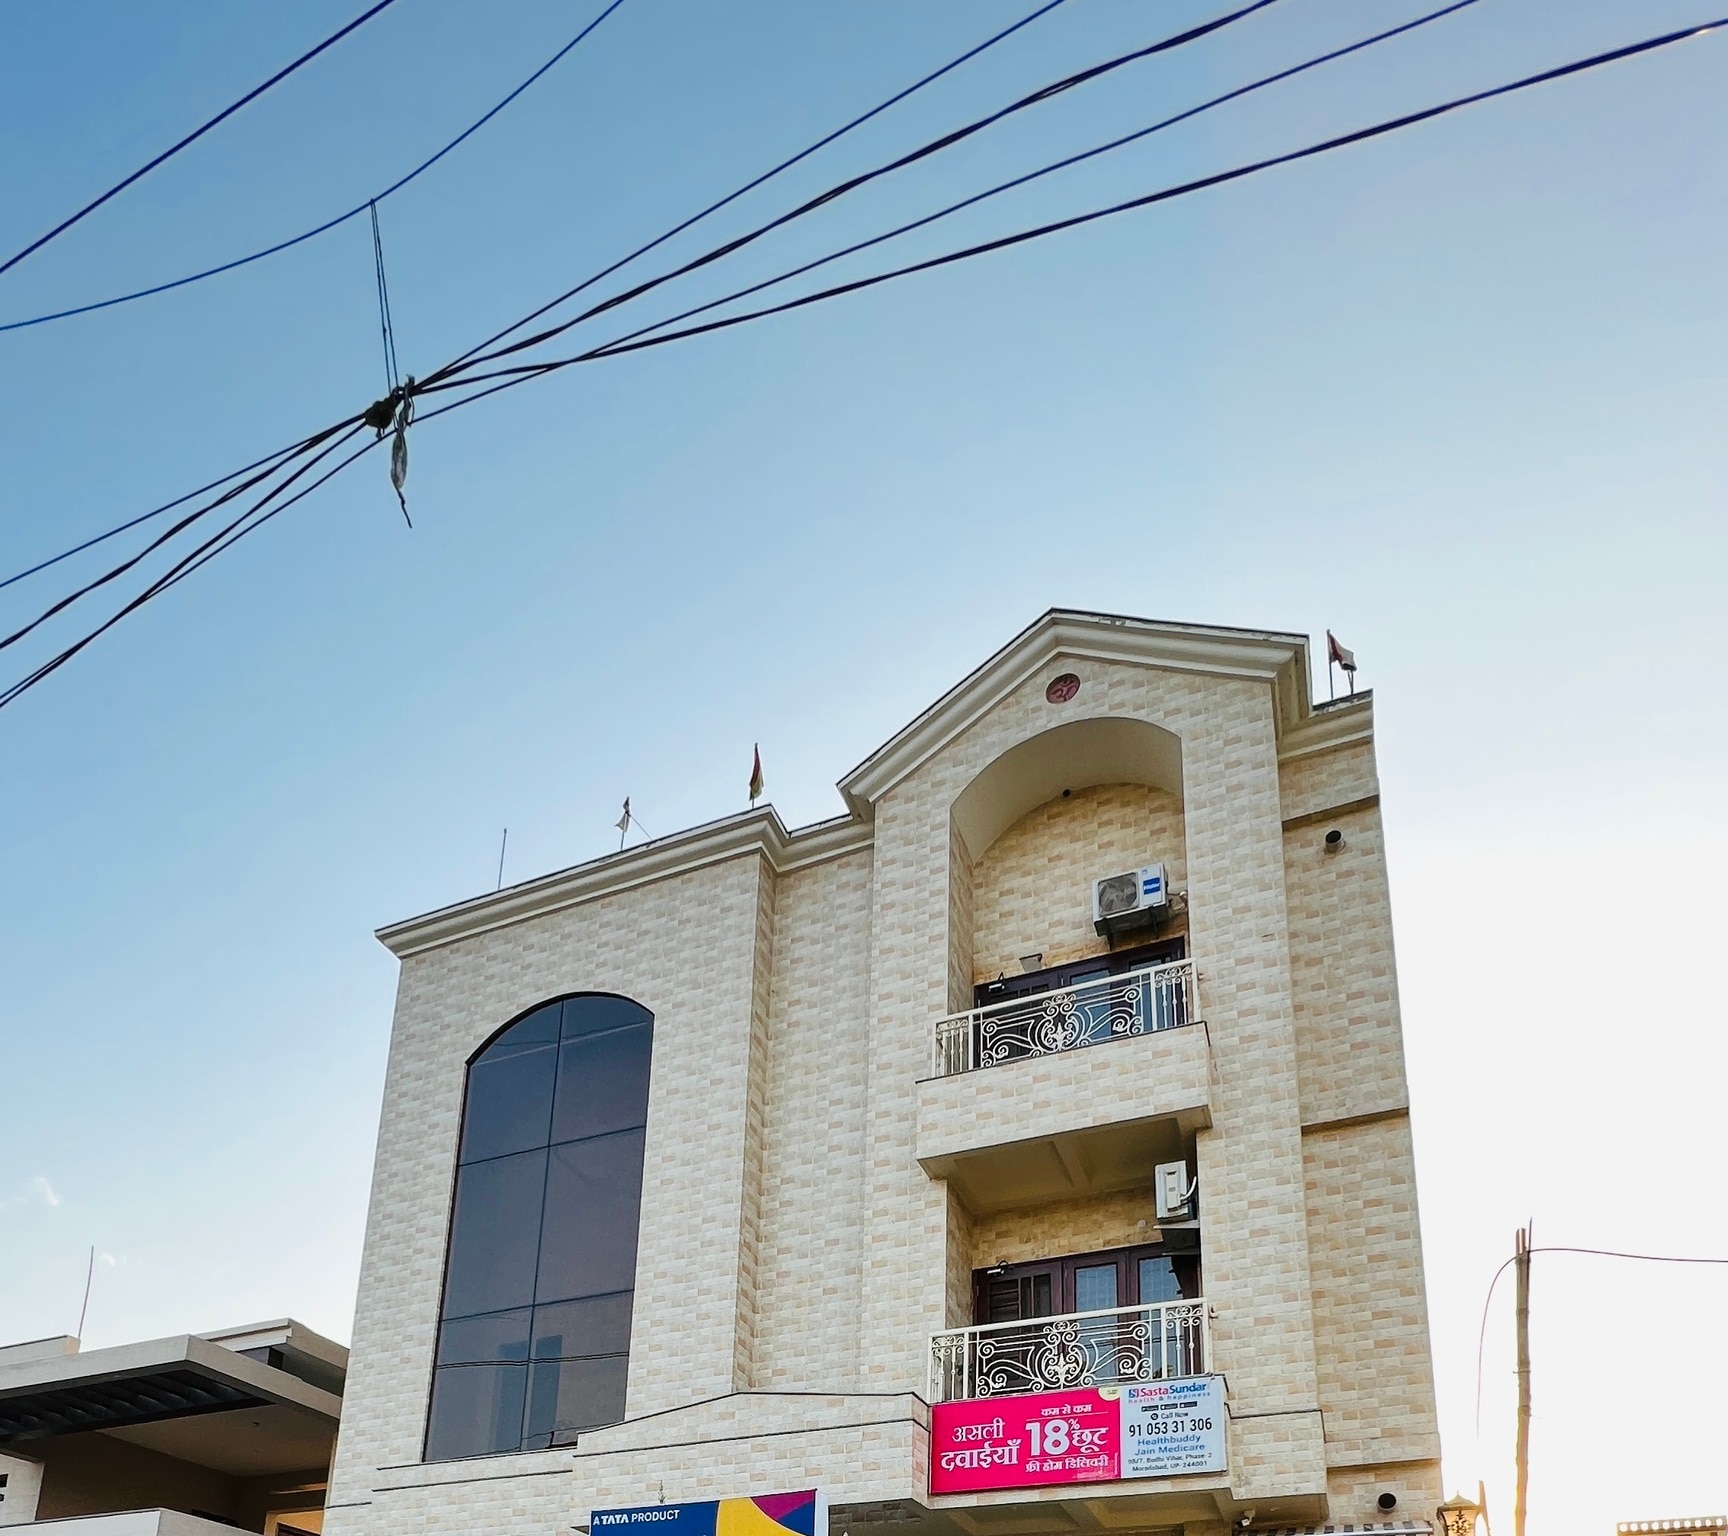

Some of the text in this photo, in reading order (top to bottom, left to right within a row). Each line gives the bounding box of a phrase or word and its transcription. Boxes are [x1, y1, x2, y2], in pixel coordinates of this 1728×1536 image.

[1140, 1382, 1207, 1397] SastaSundar
[1167, 1392, 1211, 1400] happiness
[1041, 1407, 1060, 1416] कम
[1073, 1404, 1092, 1413] कम
[1161, 1412, 1173, 1420] Call
[952, 1417, 1005, 1442] असली
[1129, 1417, 1212, 1437] 91 053 31 306
[1071, 1427, 1109, 1453] छूट
[1137, 1434, 1201, 1446] Healthbuddy
[940, 1438, 1022, 1471] दवाईयाँ
[1134, 1444, 1206, 1456] Jain Medicare
[1043, 1459, 1064, 1471] होम
[593, 1510, 680, 1525] A TATA PRODUCT
